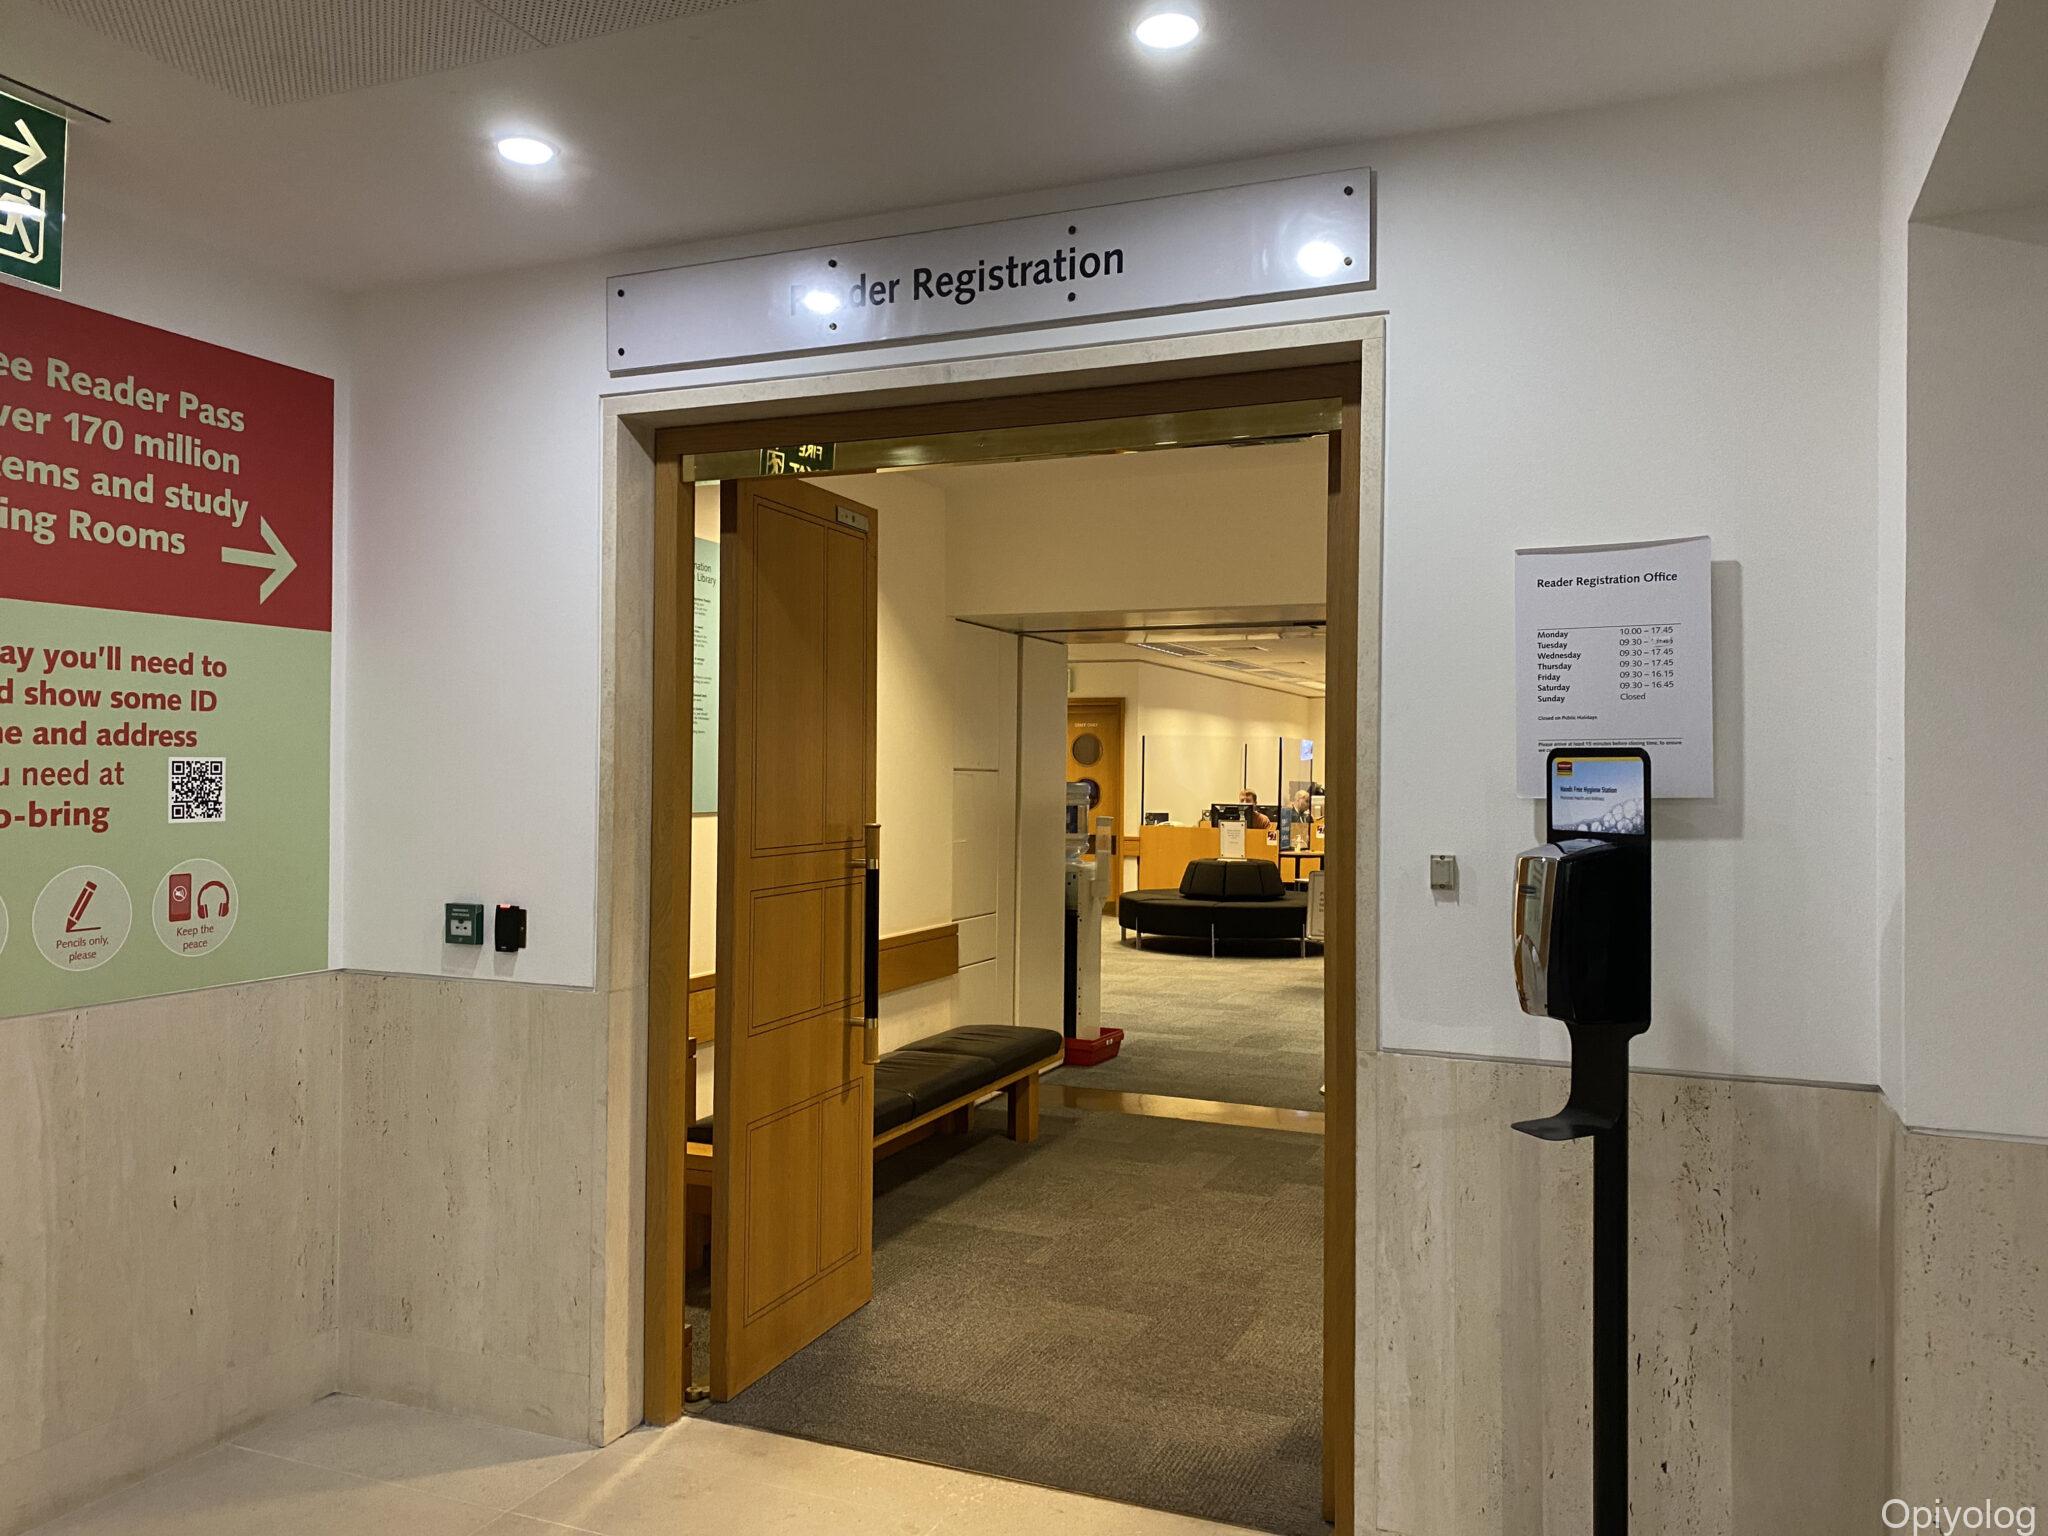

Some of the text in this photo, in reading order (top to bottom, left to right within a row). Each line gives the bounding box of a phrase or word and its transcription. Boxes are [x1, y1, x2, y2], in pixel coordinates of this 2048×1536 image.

[789, 247, 1124, 316] Rder Registration
[47, 357, 171, 414] Reader
[179, 391, 245, 432] Pass
[63, 412, 124, 450] 170
[134, 432, 240, 475] million
[0, 454, 249, 528] ems and study
[0, 497, 186, 555] ing Rooms
[694, 562, 711, 572] ation
[1537, 572, 1678, 588] Reader Registration Office
[1537, 631, 1568, 639] Monday
[1651, 626, 1674, 634] 17.45
[1537, 642, 1568, 650] Tuesday
[1620, 638, 1642, 646] 09.30
[1537, 652, 1581, 660] Wednesday
[1620, 649, 1642, 657] 09.30
[43, 646, 122, 675] you'll
[130, 652, 194, 676] need
[202, 656, 228, 678] to
[1537, 663, 1572, 671] Thursday
[1620, 660, 1642, 668] 09.30
[1537, 684, 1570, 692] Saturday
[1651, 680, 1674, 688] 16.45
[24, 680, 101, 707] show
[110, 690, 182, 711] some
[190, 690, 218, 712] ID
[1537, 695, 1565, 703] Sunday
[0, 720, 198, 748] e and address
[22, 760, 89, 786] need
[99, 762, 124, 786] at
[176, 924, 214, 938] Keep the
[56, 937, 86, 949] Pencils
[183, 939, 208, 952] peace
[69, 951, 97, 963] please
